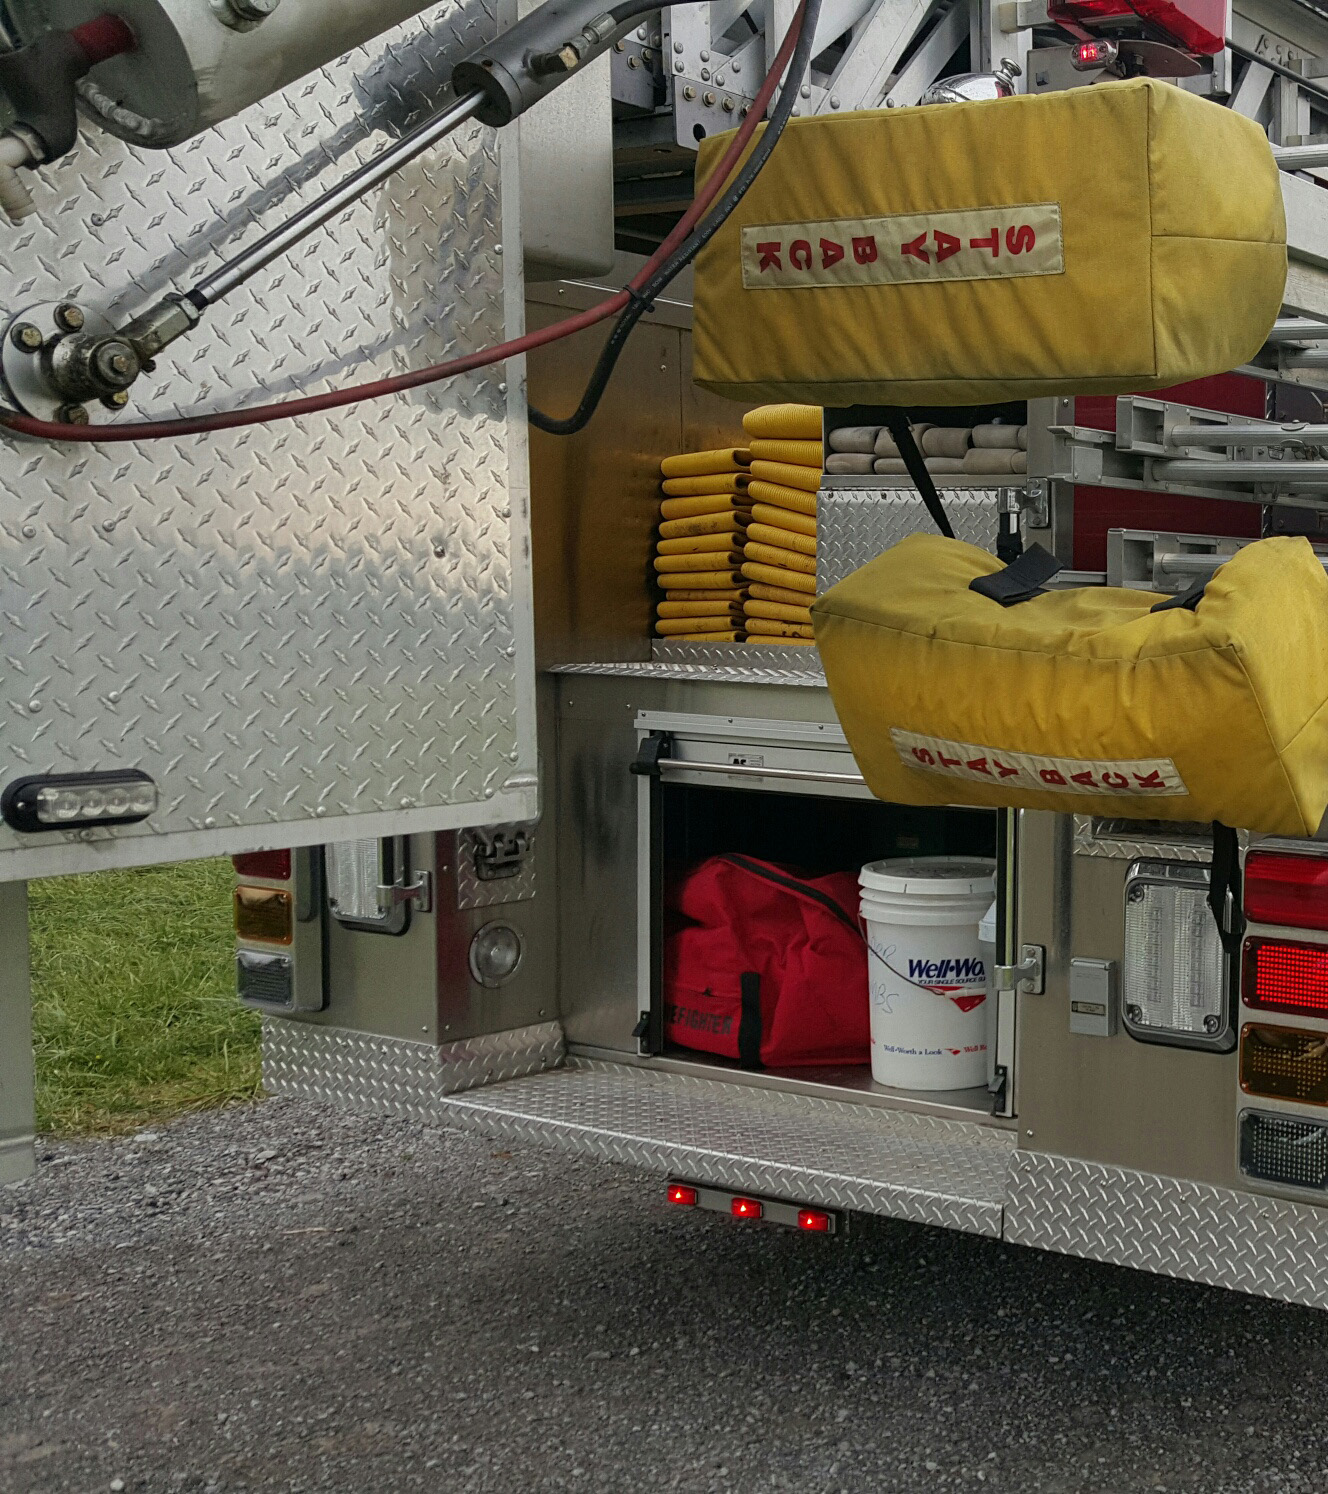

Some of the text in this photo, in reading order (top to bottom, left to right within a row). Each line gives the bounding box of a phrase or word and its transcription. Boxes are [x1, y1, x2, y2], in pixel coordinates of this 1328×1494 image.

[756, 224, 1035, 273] STAY BACK
[911, 747, 1166, 789] STAY BACK
[672, 1005, 733, 1035] EFIGHTER
